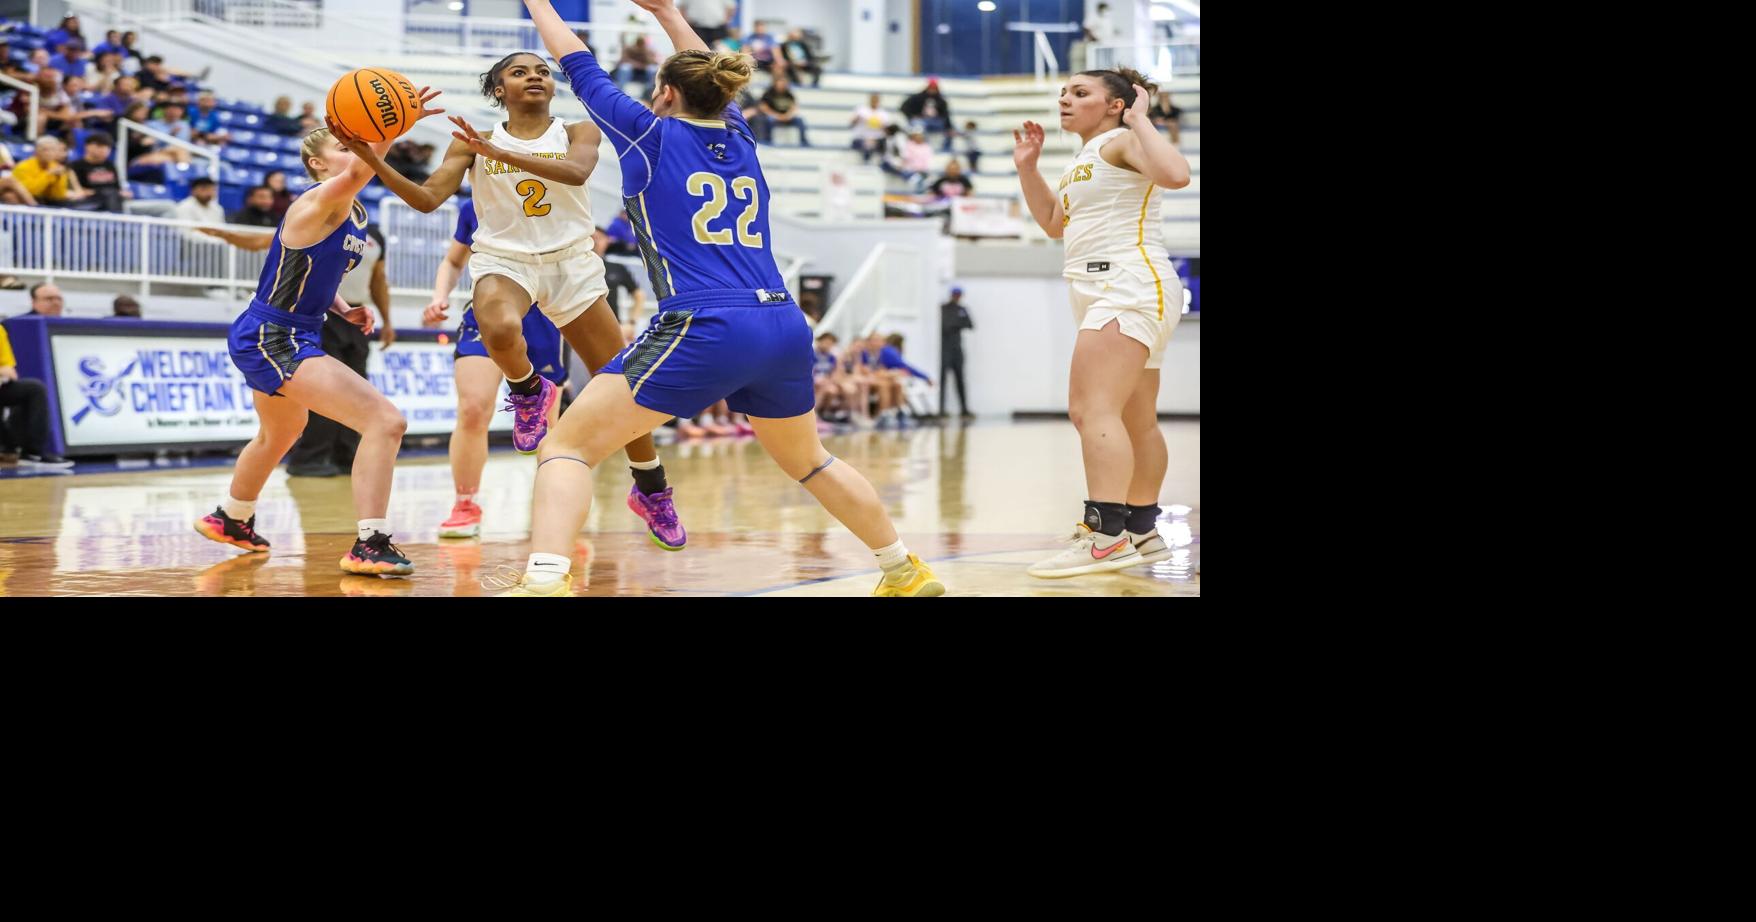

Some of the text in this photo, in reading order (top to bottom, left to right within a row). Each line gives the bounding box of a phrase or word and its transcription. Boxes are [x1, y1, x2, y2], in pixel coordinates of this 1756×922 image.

[369, 79, 398, 128] Wilson
[516, 179, 551, 217] 2
[686, 171, 763, 248] 22
[137, 350, 232, 378] WELCOME
[132, 382, 234, 412] CHIEFTAIN
